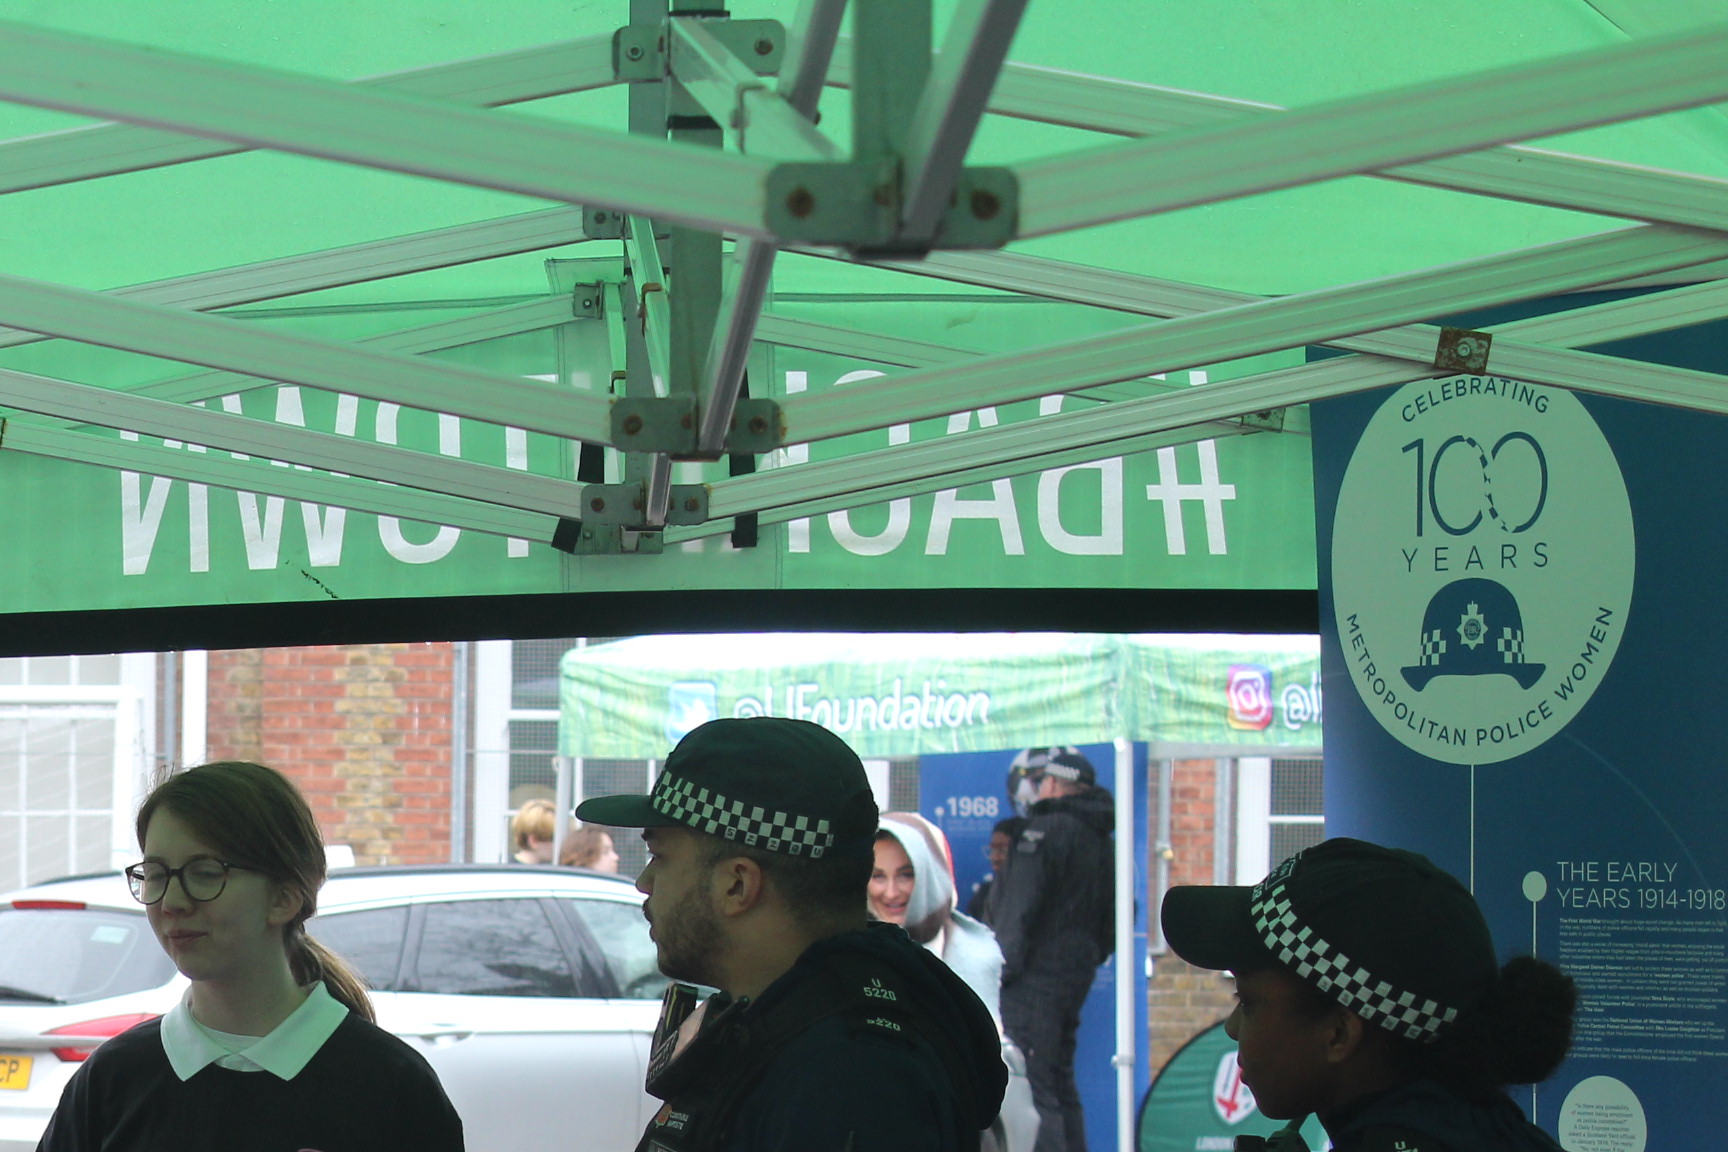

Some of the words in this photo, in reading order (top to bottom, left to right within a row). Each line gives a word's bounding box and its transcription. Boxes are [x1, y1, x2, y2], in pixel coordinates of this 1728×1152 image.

[1401, 376, 1550, 423] CELEBRATING
[1401, 431, 1549, 538] 100
[1402, 542, 1550, 573] YEARS
[1346, 612, 1468, 747] METROPOLITAN
[1475, 702, 1554, 747] POLICE
[1554, 606, 1614, 702] WOMEN
[946, 795, 1000, 818] 1968
[1557, 861, 1601, 883] THE
[1608, 862, 1678, 883] EARLY
[1556, 888, 1630, 909] YEARS
[1638, 889, 1727, 911] 1914-1918
[863, 986, 897, 1001] 5220
[1394, 1141, 1406, 1150] U
